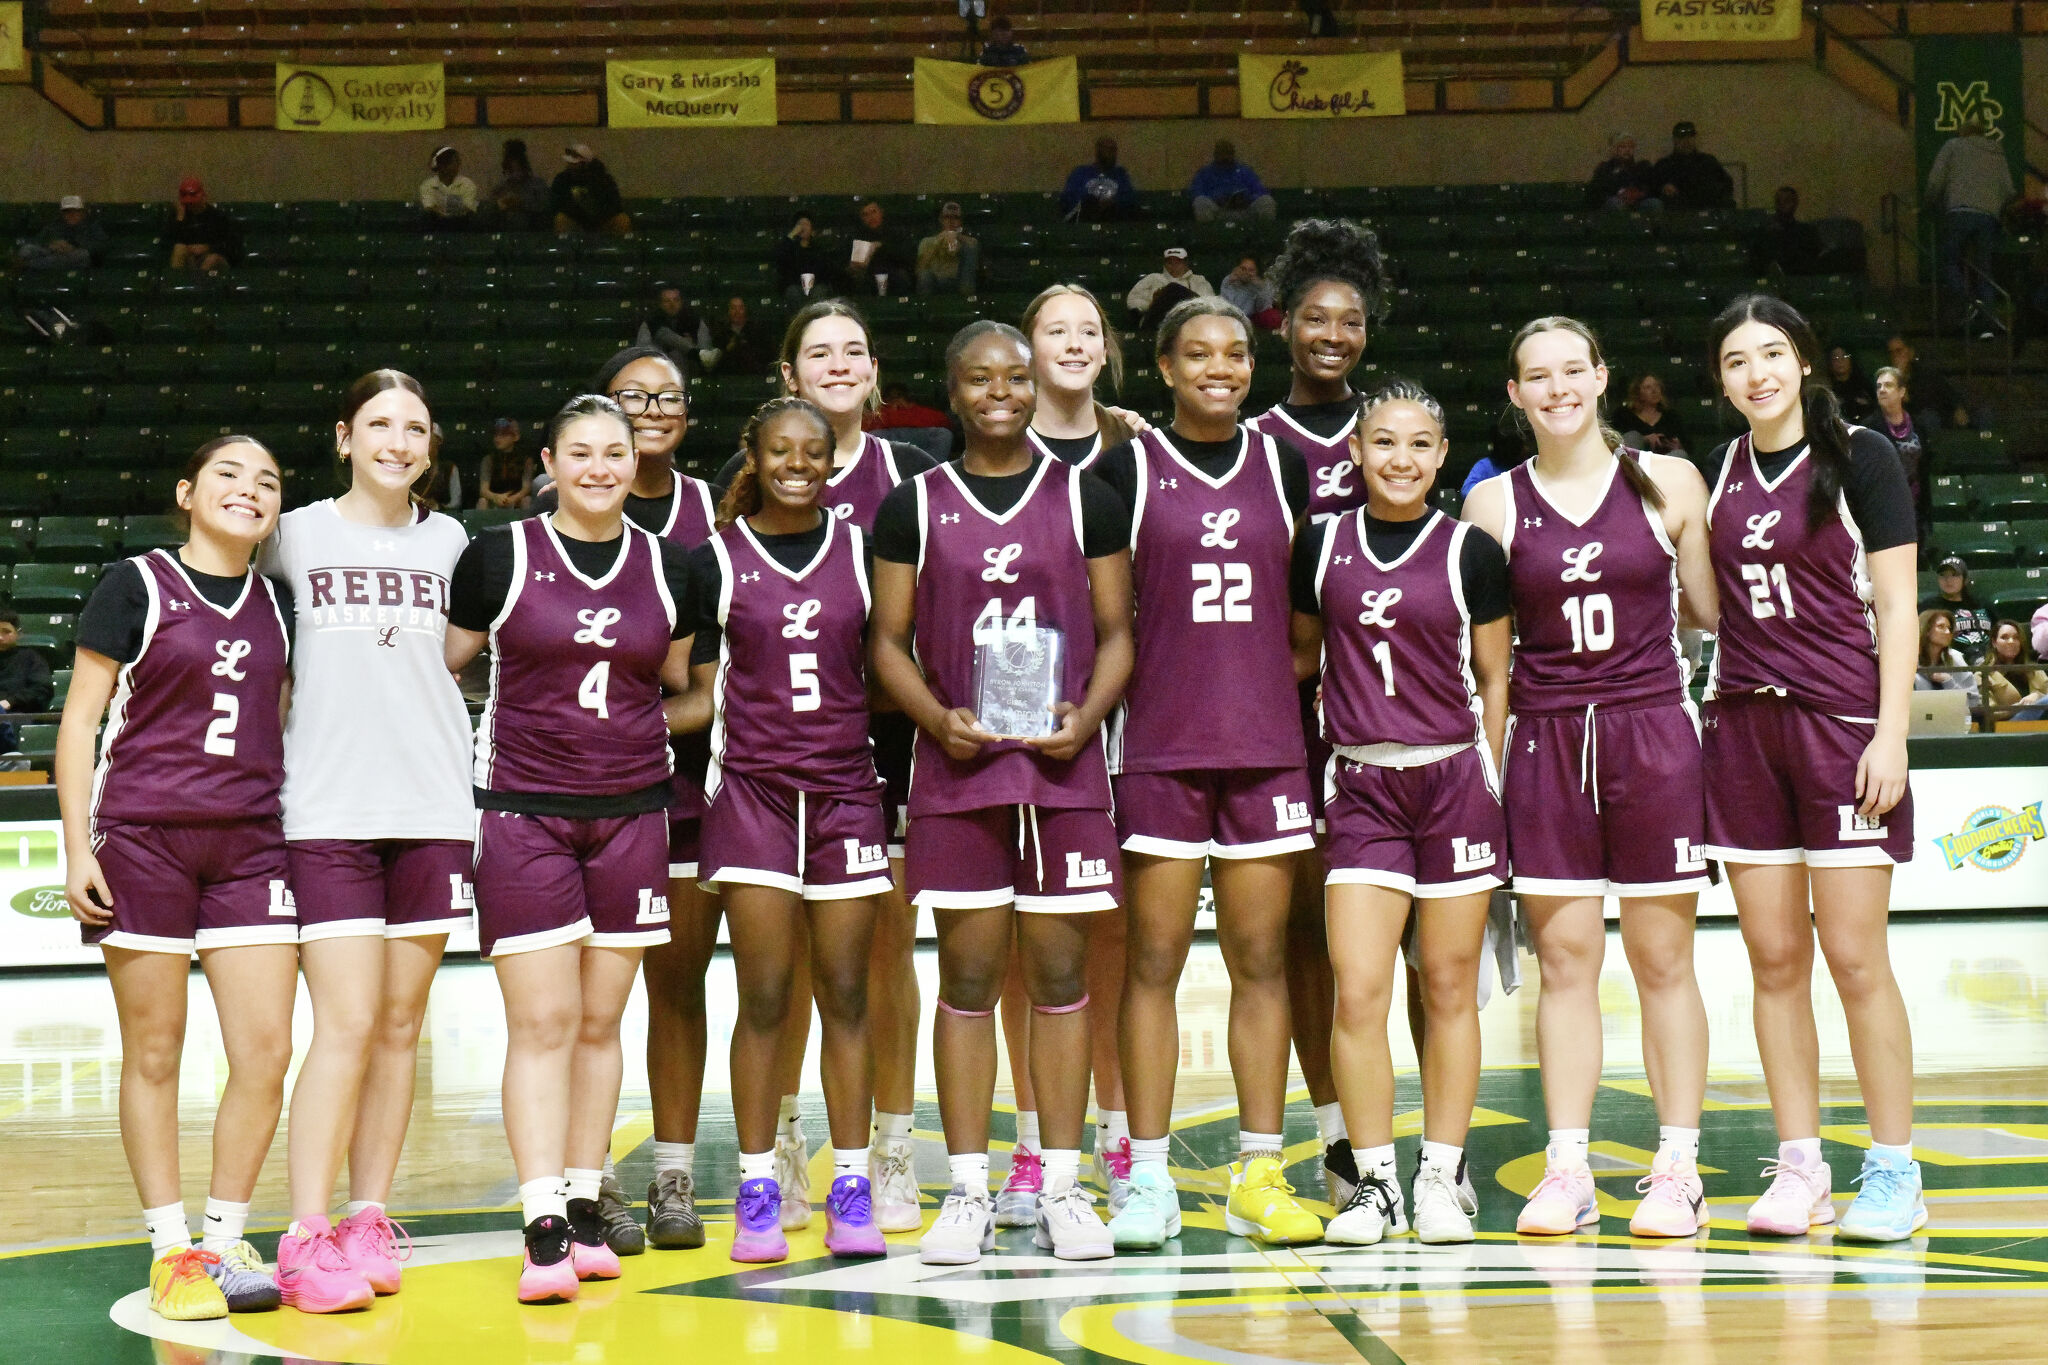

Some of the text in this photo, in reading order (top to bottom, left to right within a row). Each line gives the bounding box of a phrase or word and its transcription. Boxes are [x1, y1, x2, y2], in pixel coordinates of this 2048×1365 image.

[1655, 0, 1775, 16] FASTSIGNS
[1674, 22, 1767, 31] MIDLAND
[344, 79, 442, 99] Gateway
[621, 72, 761, 92] Gary & Marsha
[990, 83, 1004, 104] 5
[350, 99, 437, 124] Royalty
[646, 100, 739, 117] McQuerry
[1316, 460, 1354, 498] L
[1201, 508, 1241, 550] L
[1742, 510, 1782, 550] L
[981, 543, 1023, 584] L
[1561, 542, 1604, 583] L
[1192, 563, 1253, 623] 22
[1358, 588, 1403, 629] L
[1742, 563, 1797, 619] 21
[312, 606, 447, 632] BASKETBAL
[377, 625, 400, 648] L
[573, 607, 622, 648] L
[782, 599, 822, 640] L
[973, 596, 1038, 653] 44
[1561, 593, 1615, 653] 10
[211, 639, 252, 681] L
[1372, 640, 1396, 697] 1
[578, 660, 611, 719] 4
[789, 653, 822, 713] 5
[203, 692, 240, 757] 2
[1941, 805, 2046, 870] FUDDRUCKERS
[29, 890, 71, 912] For
